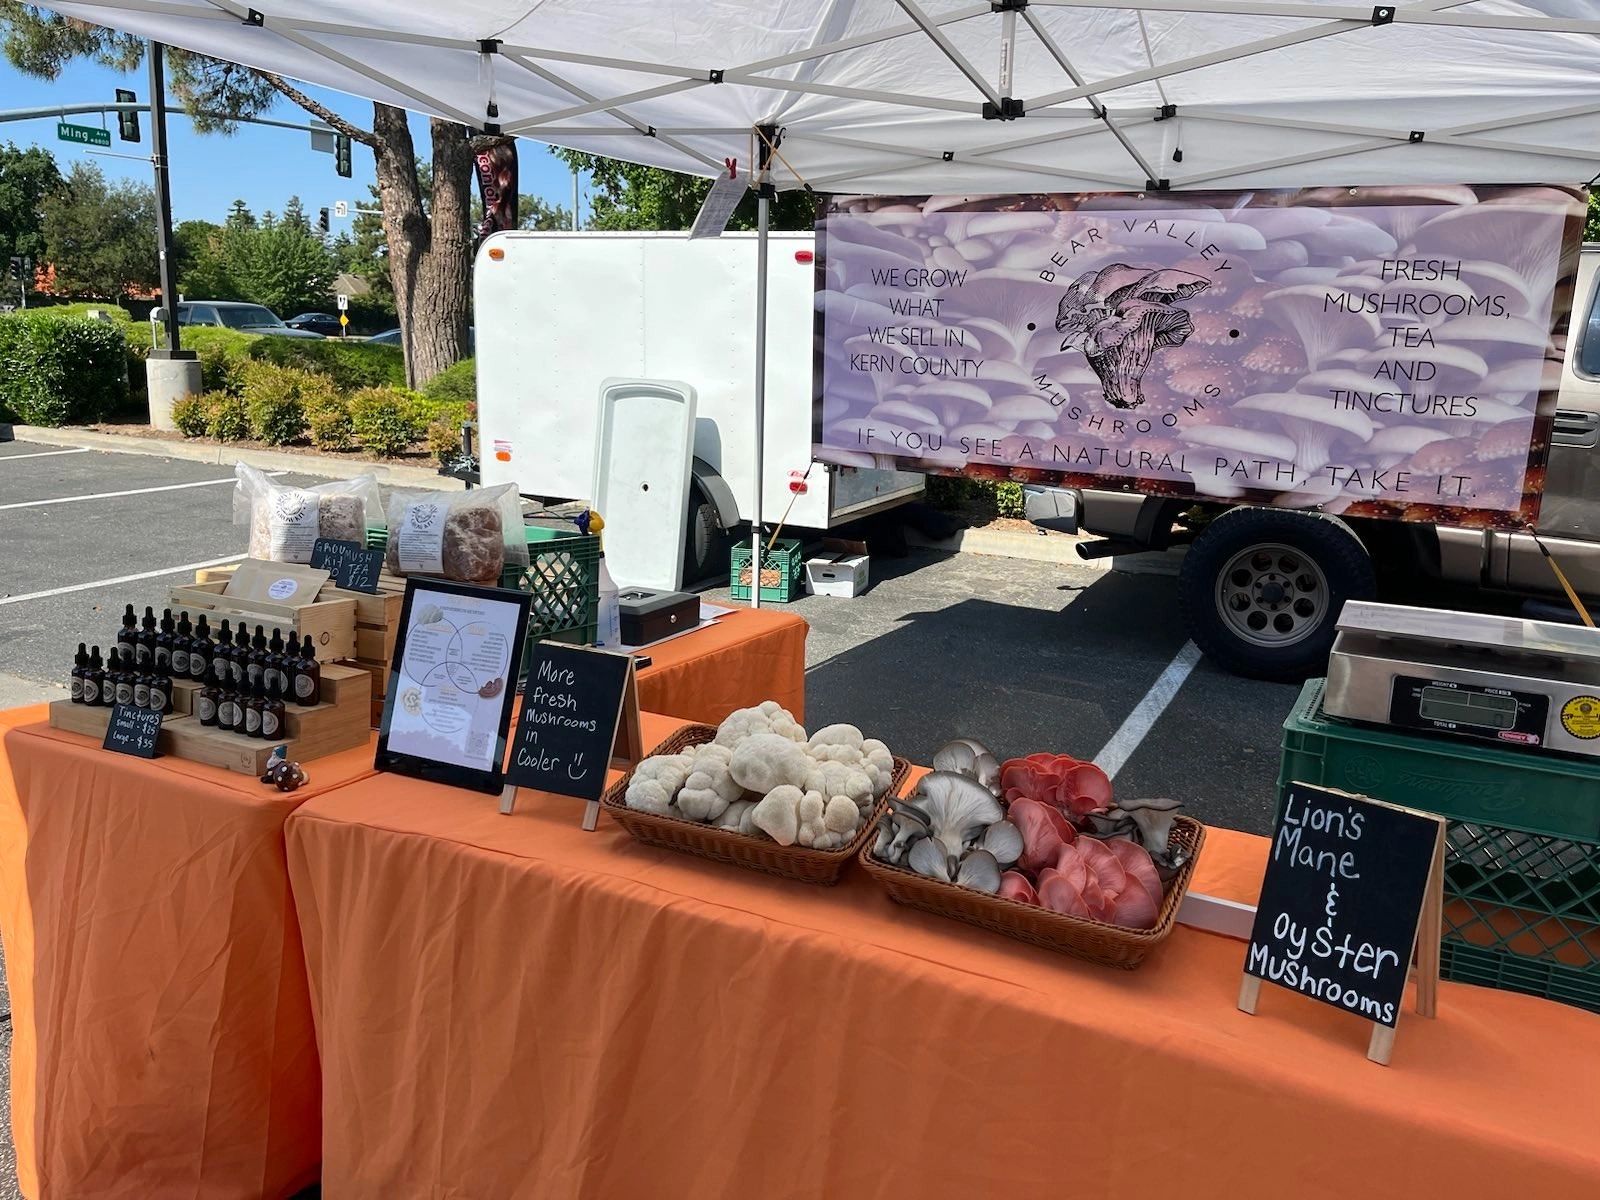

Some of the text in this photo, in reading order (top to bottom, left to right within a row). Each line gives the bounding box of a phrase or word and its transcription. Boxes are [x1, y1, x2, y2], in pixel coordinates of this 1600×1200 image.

[61, 126, 89, 142] Ming
[1039, 218, 1232, 283] BEAR VALLEY
[871, 268, 968, 288] WE GROW
[1381, 260, 1461, 282] FRESH
[889, 298, 945, 317] WHAT
[1323, 292, 1511, 319] MUSHROOMS,
[868, 326, 964, 347] WE SELL IN
[1388, 327, 1435, 349] TEA
[850, 354, 984, 377] KERN COUNTY
[1373, 360, 1437, 381] AND
[1034, 374, 1221, 433] MUSHROOMS
[1329, 390, 1478, 417] TINCTURES
[857, 428, 1477, 498] IF YOU SEE A NATURAL PATH, TAKE IT.
[344, 549, 373, 563] MUSH
[348, 563, 369, 575] TEA
[347, 574, 372, 587] $12
[538, 660, 575, 686] More
[533, 686, 577, 711] fresh
[119, 705, 160, 726] Tinctures
[525, 708, 597, 732] Mushrooms
[136, 735, 153, 749] $35
[525, 726, 538, 744] in
[517, 747, 560, 771] Cooler
[1284, 793, 1366, 841] Lion's
[1274, 825, 1360, 879] Mane
[1248, 941, 1394, 1024] Mushrooms
